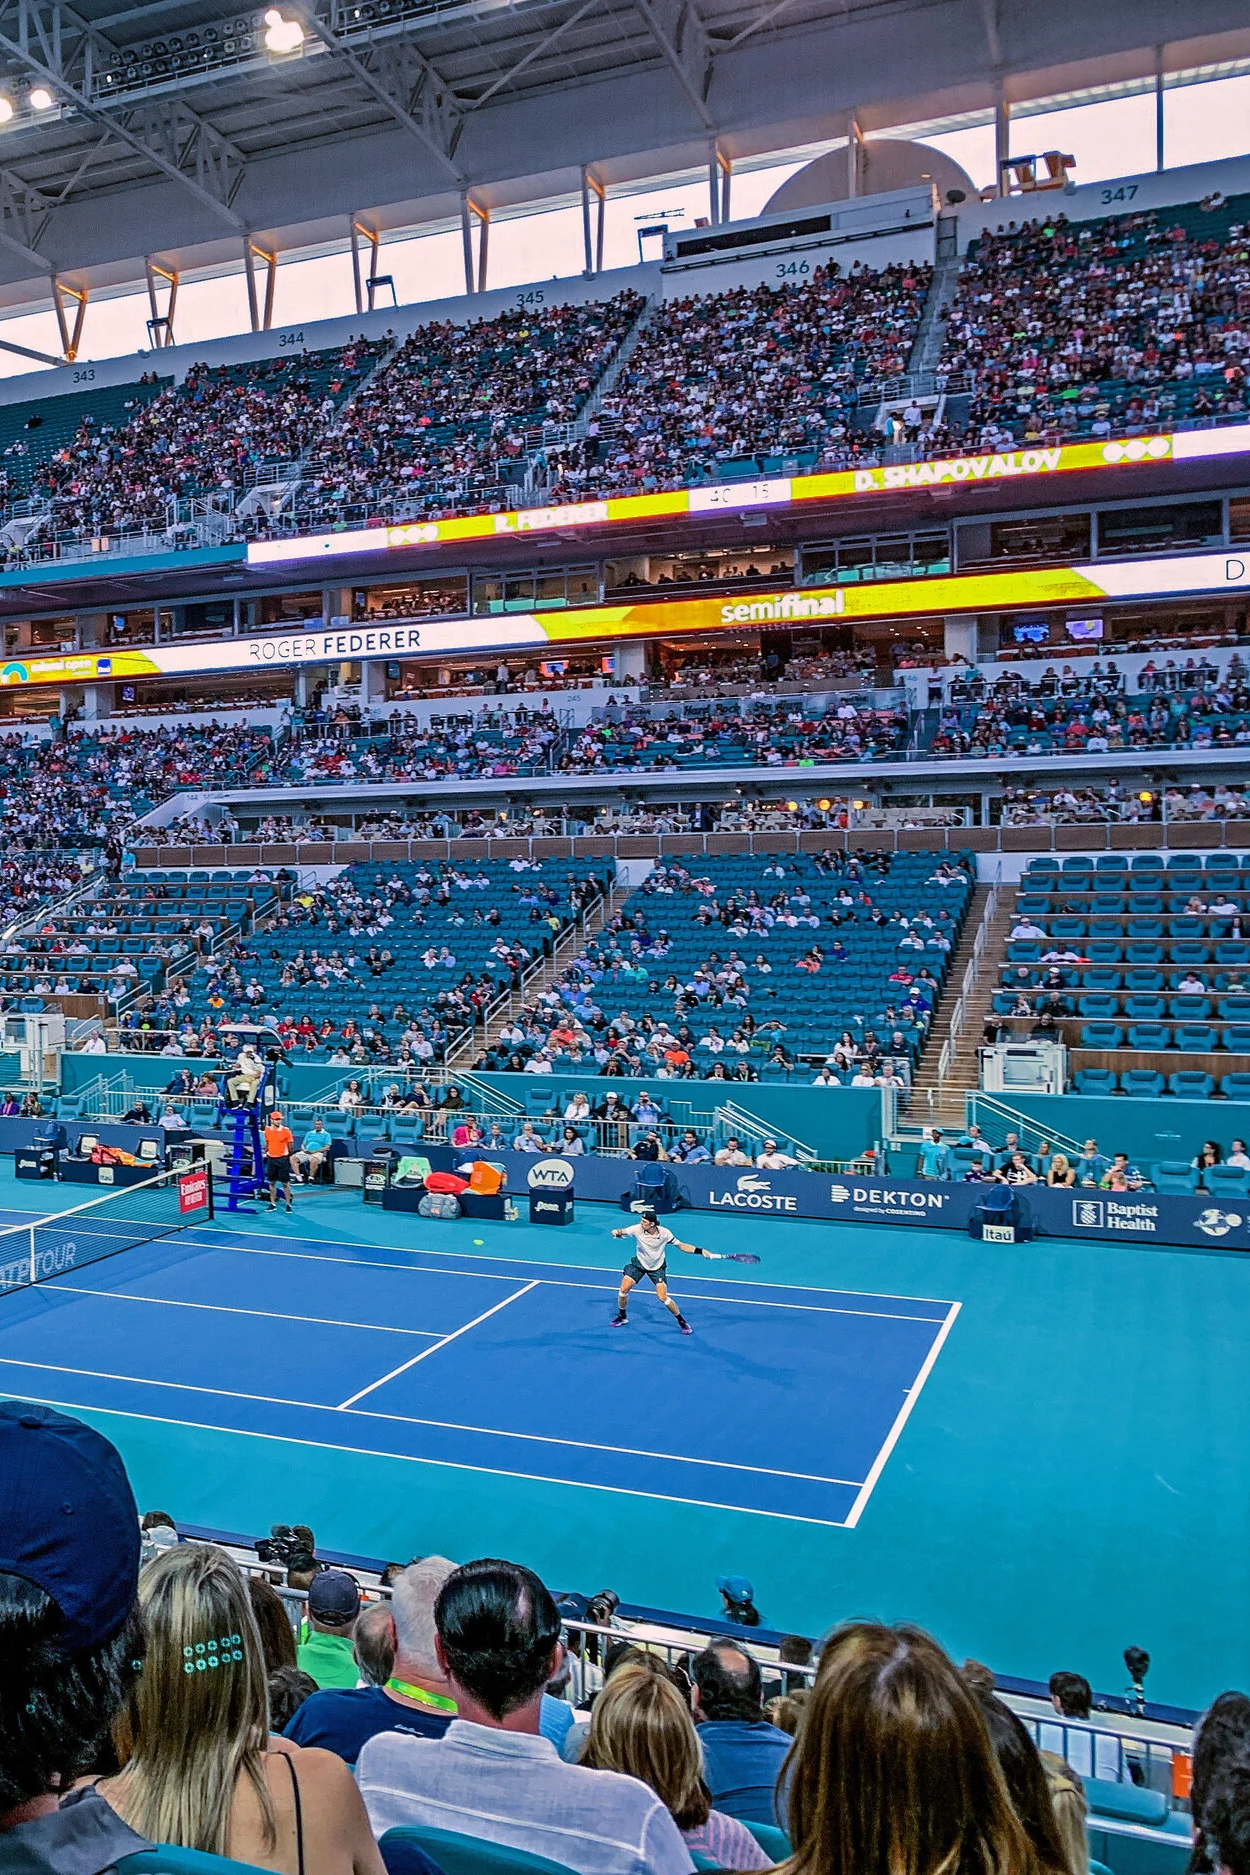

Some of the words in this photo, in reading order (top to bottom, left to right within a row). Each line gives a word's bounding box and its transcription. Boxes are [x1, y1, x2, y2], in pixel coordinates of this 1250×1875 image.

[1101, 184, 1139, 205] 347
[776, 260, 810, 278] 346
[516, 290, 544, 306] 345
[279, 331, 305, 347] 344
[72, 369, 95, 384] 343
[854, 470, 880, 492] D.
[883, 448, 1063, 489] SHAPOVALOV
[721, 589, 845, 623] semifinal
[250, 638, 317, 660] ROGER
[323, 630, 421, 654] FEDERER
[532, 1168, 570, 1183] WTA
[709, 1191, 798, 1211] LACOSTE
[853, 1188, 943, 1208] DEKTON
[1107, 1201, 1159, 1217] Baptist
[1107, 1216, 1157, 1231] Health
[985, 1228, 1012, 1241] Itaú
[34, 1242, 77, 1279] TOUR
